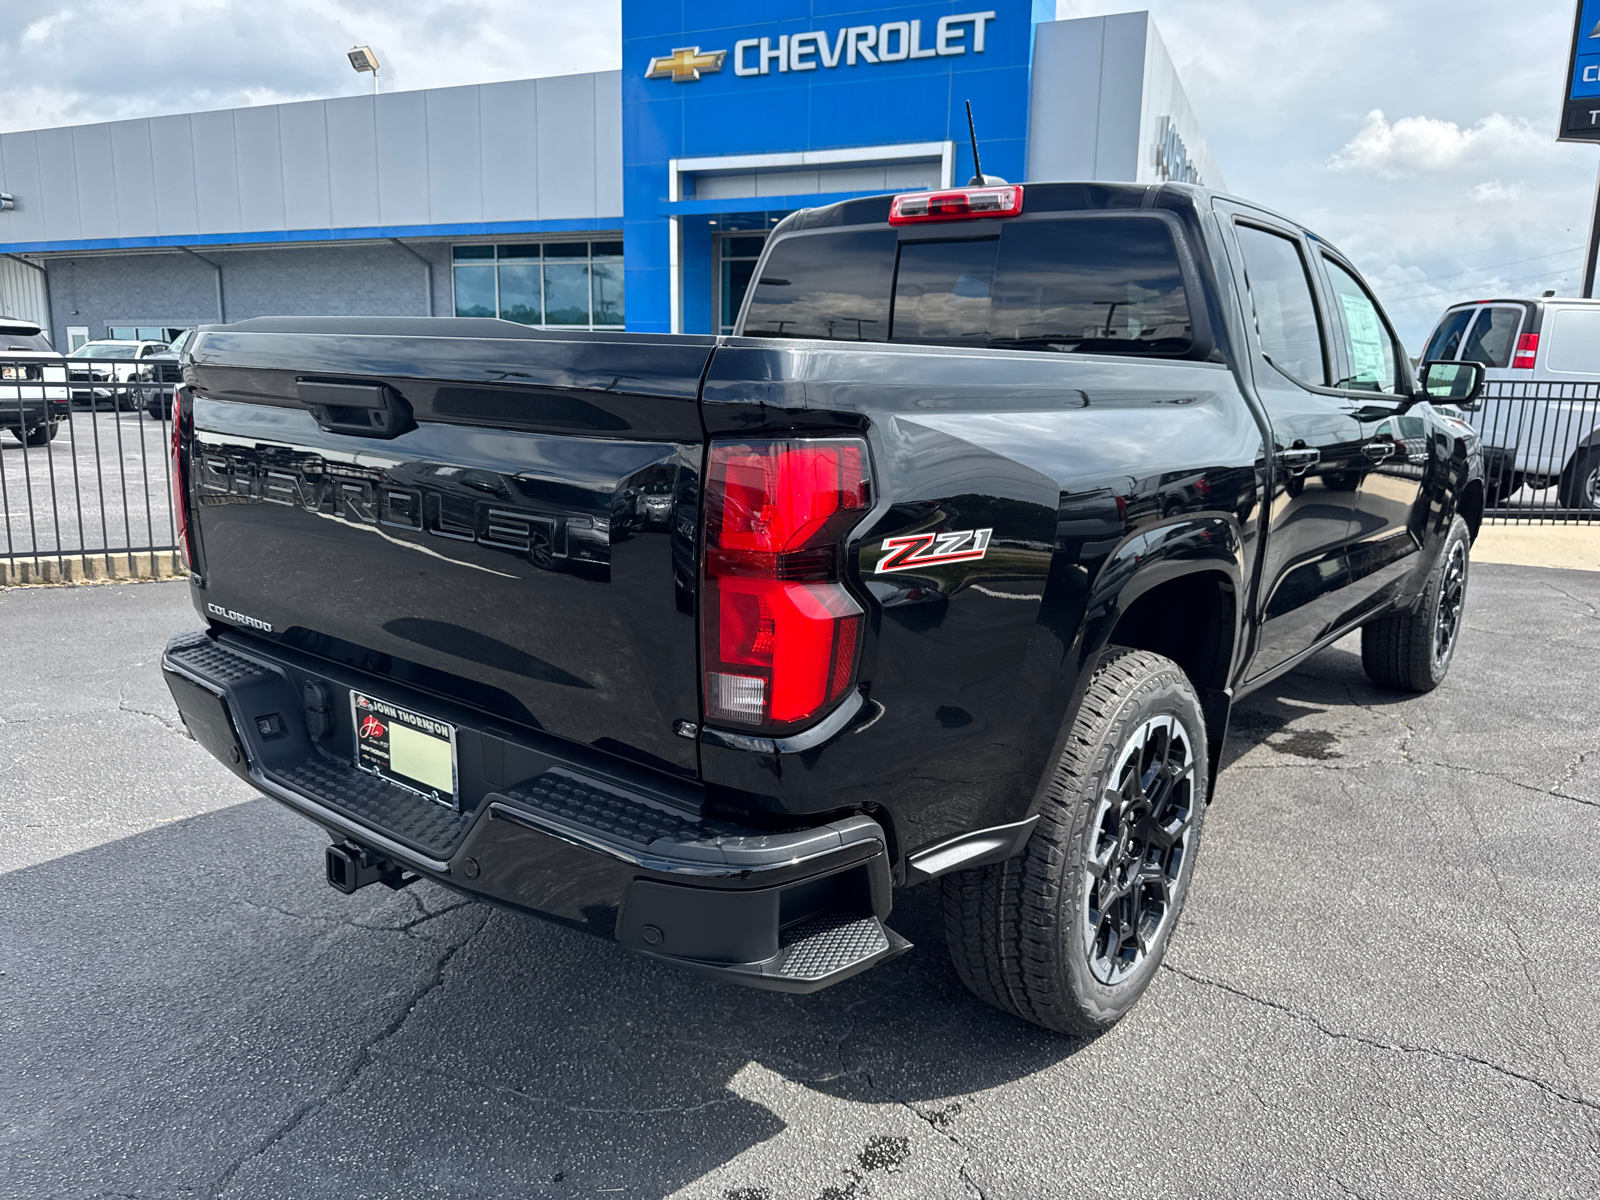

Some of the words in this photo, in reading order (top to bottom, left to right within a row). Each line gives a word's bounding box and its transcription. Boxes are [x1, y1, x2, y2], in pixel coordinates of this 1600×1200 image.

[734, 10, 996, 76] CHEVROLET
[202, 455, 593, 558] CHEVROLET
[874, 527, 993, 574] Z71
[207, 602, 273, 632] COLORADO
[373, 700, 398, 718] JOHN
[397, 710, 449, 738] THORNTON
